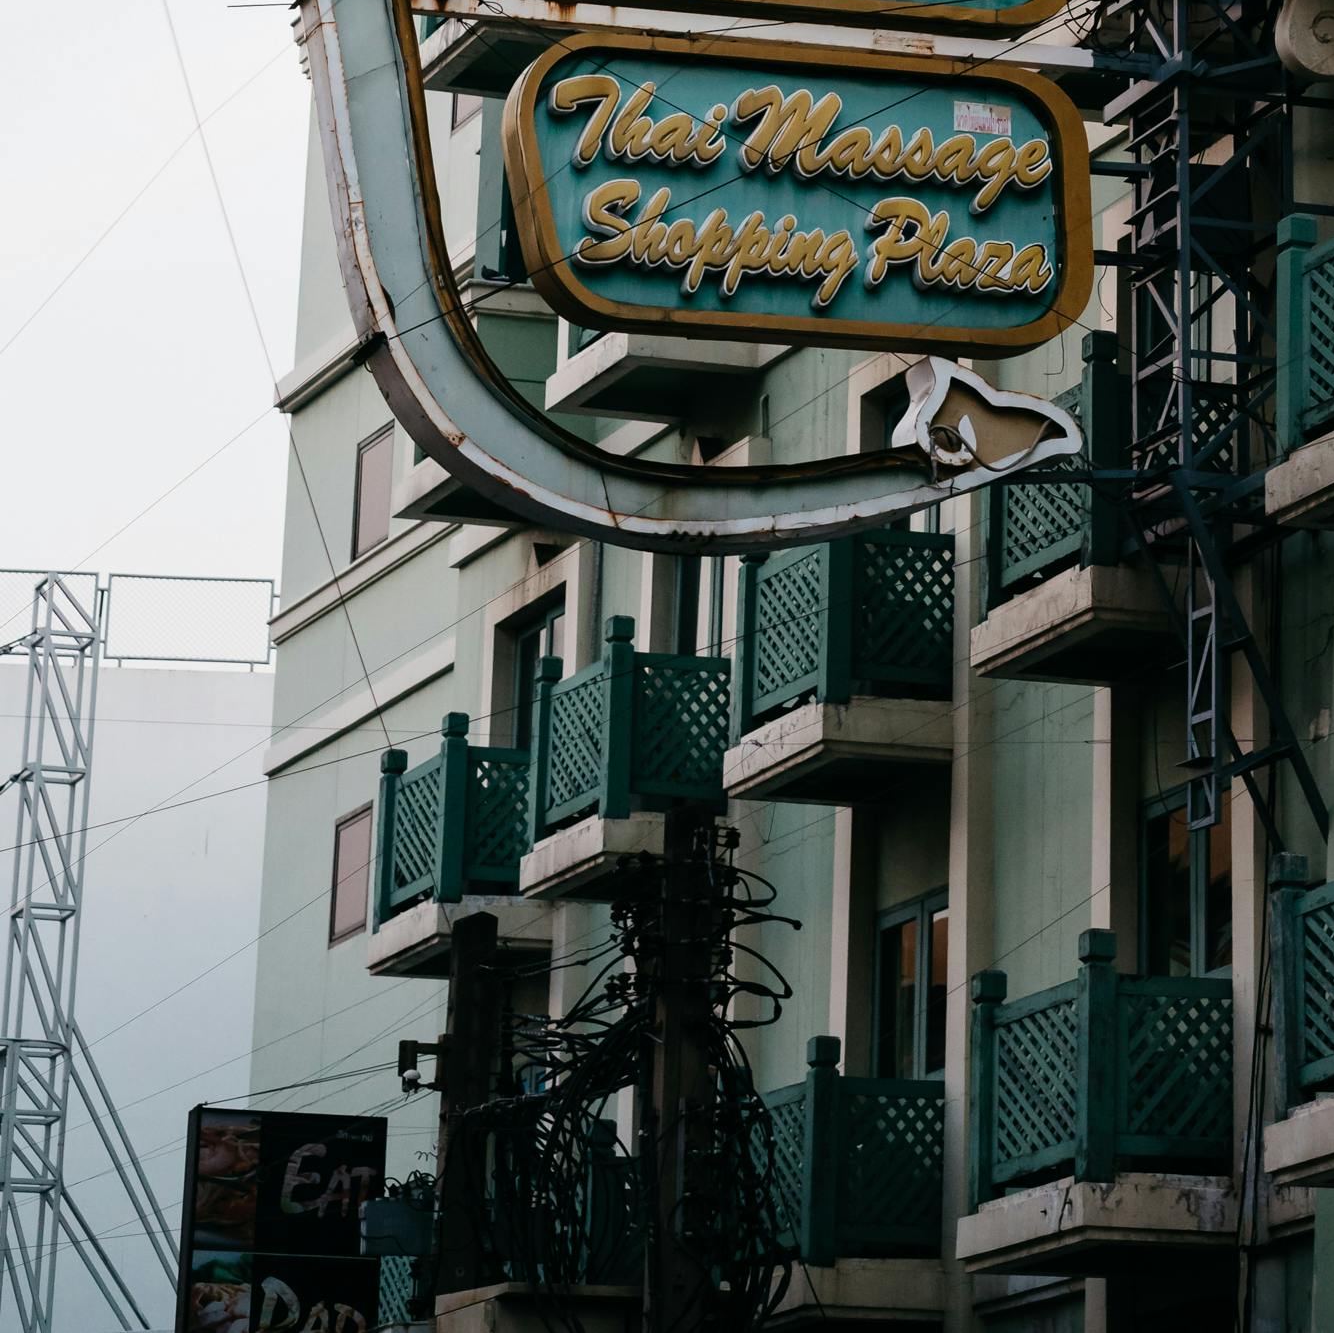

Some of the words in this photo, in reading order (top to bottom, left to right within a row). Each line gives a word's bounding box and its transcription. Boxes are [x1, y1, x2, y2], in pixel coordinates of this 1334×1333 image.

[547, 74, 727, 170] Thai
[731, 84, 1053, 216] Massage
[573, 179, 860, 310] Shopping
[864, 195, 1055, 294] Plaza
